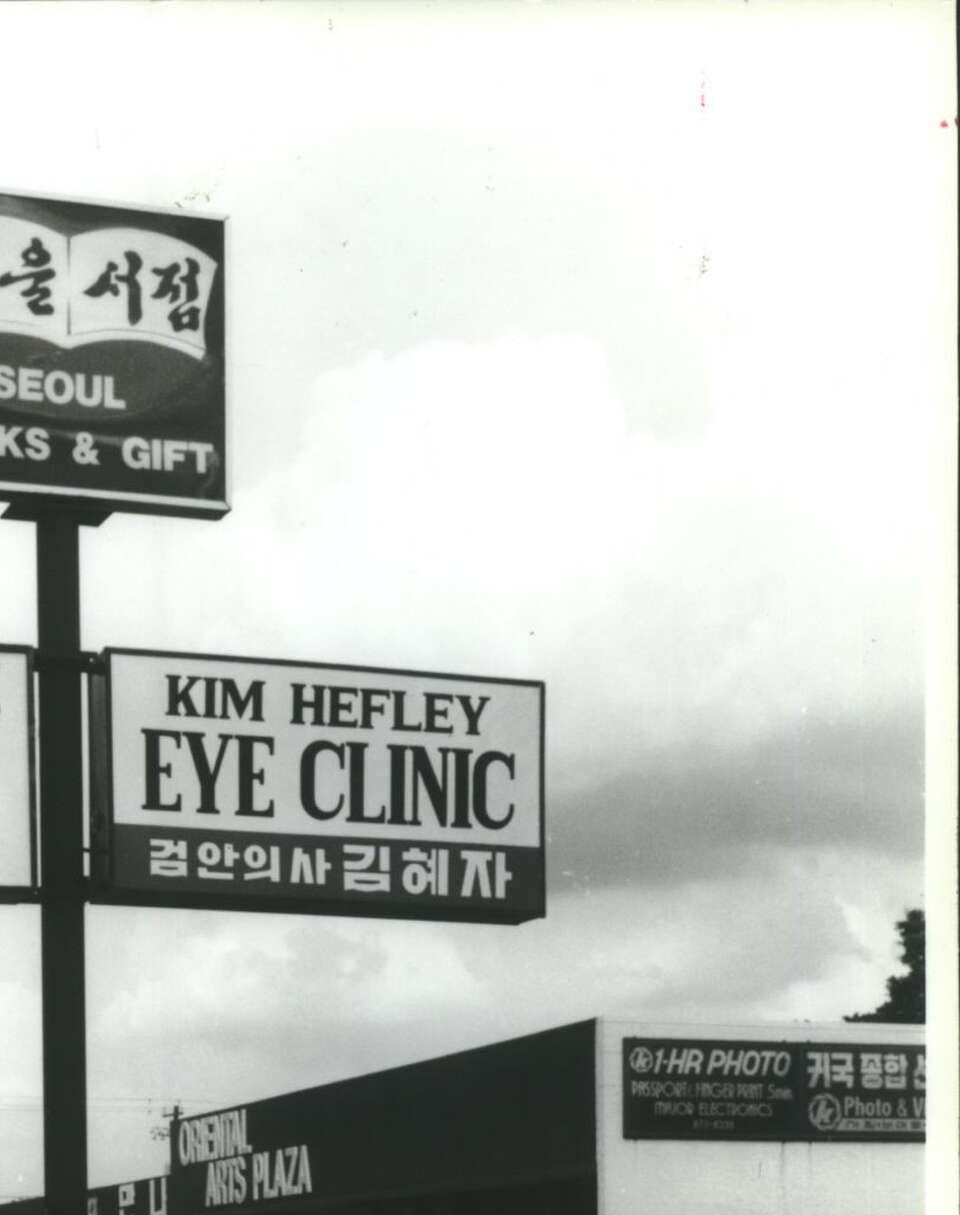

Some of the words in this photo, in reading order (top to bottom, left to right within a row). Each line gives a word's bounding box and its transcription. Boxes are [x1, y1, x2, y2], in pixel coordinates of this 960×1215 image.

[83, 250, 201, 333] 서점
[72, 432, 101, 466] &
[122, 436, 215, 474] GIFT
[165, 674, 266, 722] KIM
[289, 683, 492, 735] HEFLEY
[141, 728, 275, 818] EYE
[299, 740, 516, 830] CLINIC
[149, 838, 332, 886] 검안의사
[342, 844, 513, 900] 김혜자
[706, 1050, 792, 1077] PHOTO
[844, 1096, 892, 1117] Photo
[178, 1108, 253, 1167] ORIENTAL
[205, 1156, 247, 1207] ARTS
[252, 1144, 313, 1201] PLAZA
